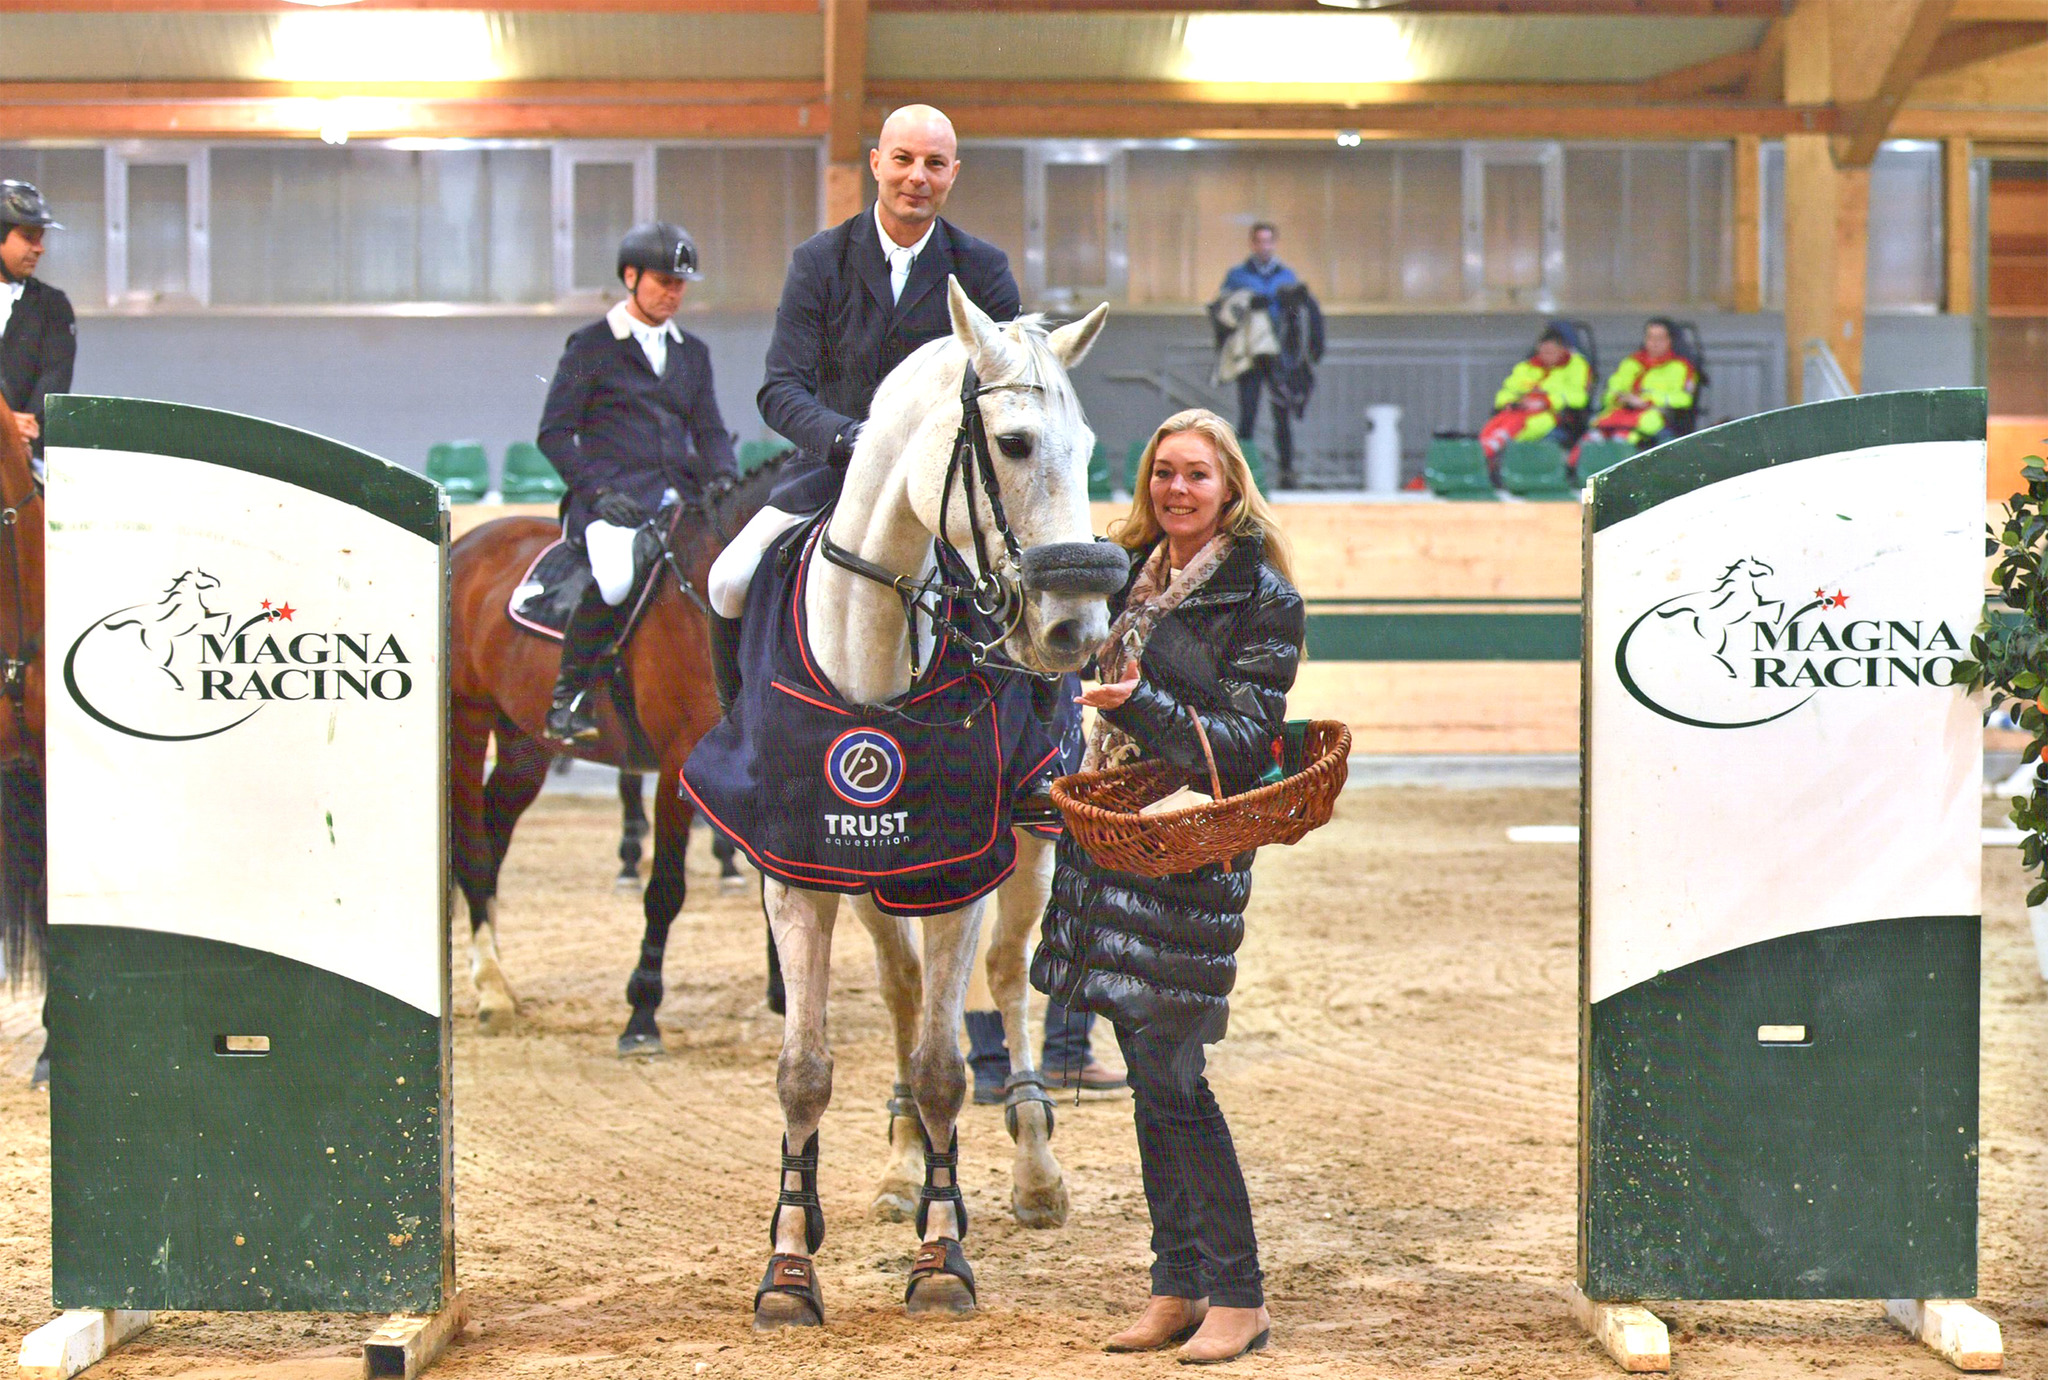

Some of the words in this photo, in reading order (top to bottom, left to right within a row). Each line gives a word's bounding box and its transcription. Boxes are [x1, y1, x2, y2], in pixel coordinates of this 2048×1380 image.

[198, 632, 411, 664] MAGNA
[1751, 620, 1963, 652] MAGNA
[197, 669, 412, 700] RACINO
[1751, 656, 1960, 688] RACINO
[824, 811, 909, 837] TRUST
